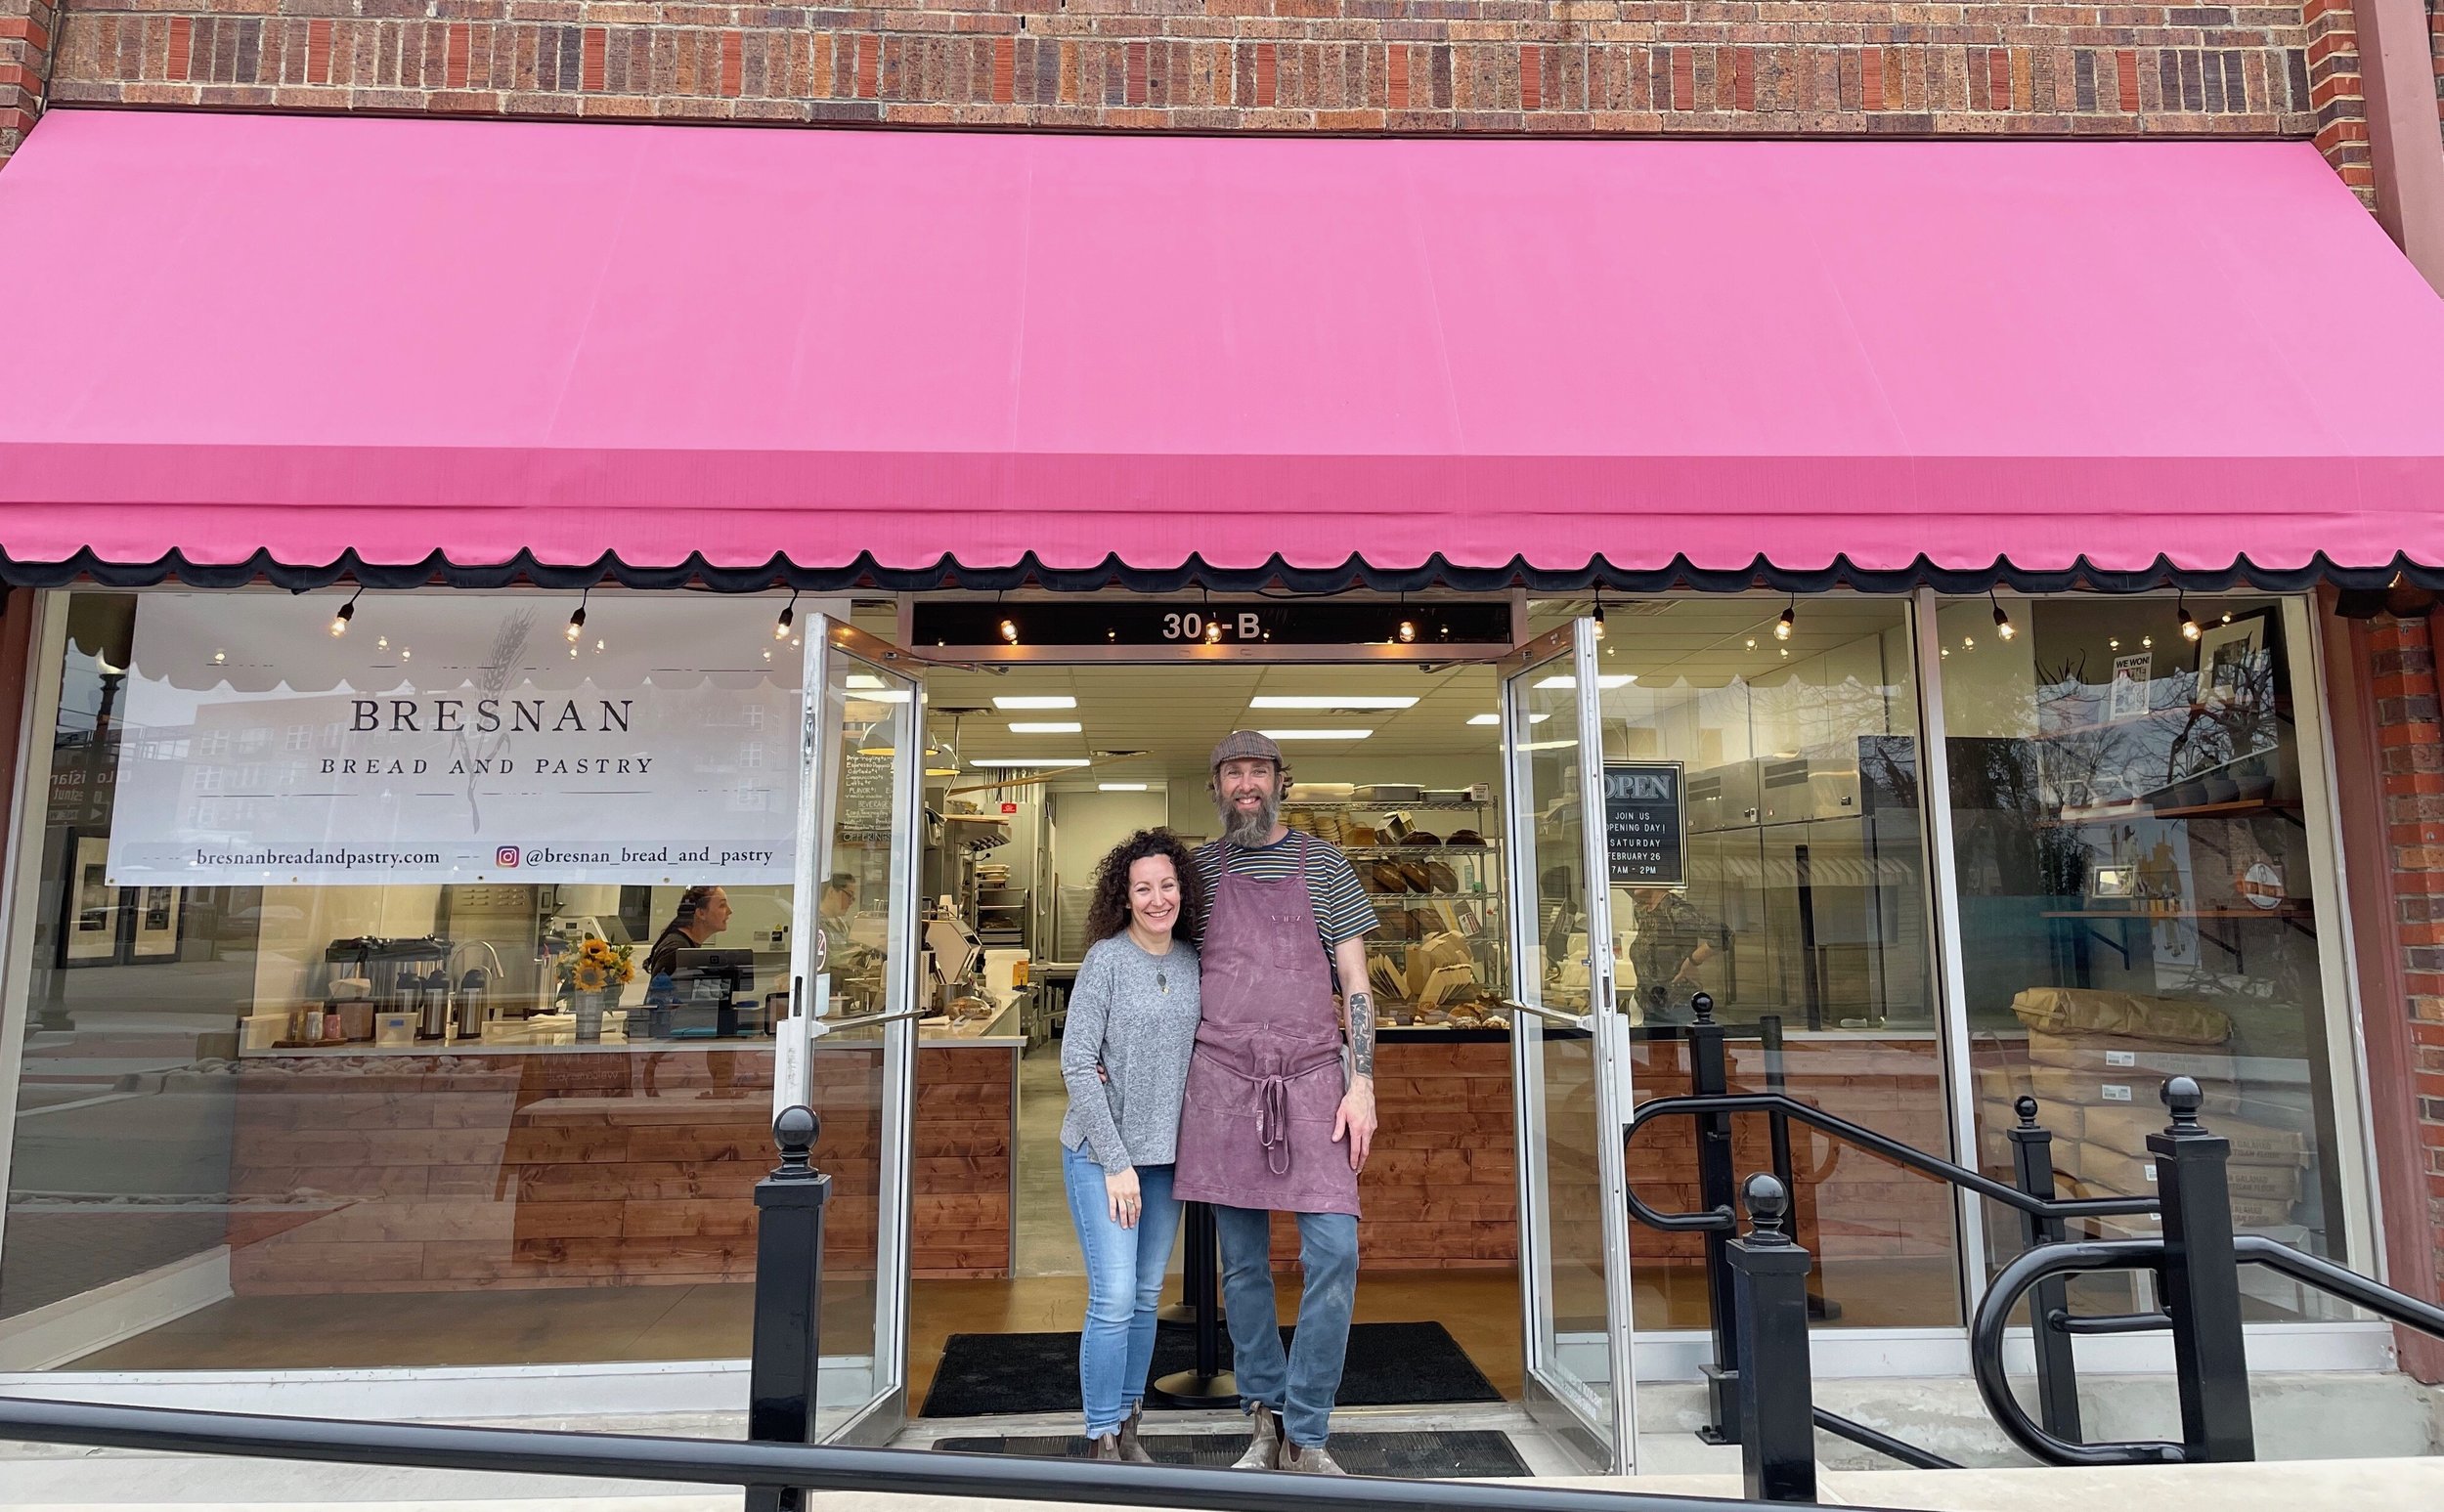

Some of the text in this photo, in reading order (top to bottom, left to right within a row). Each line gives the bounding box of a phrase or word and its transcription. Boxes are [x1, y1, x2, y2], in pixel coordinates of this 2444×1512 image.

[1162, 612, 1260, 639] 30-B
[2116, 660, 2129, 669] WE
[349, 699, 633, 733] BRESNAN
[321, 757, 653, 774] BREAD AND PASTRY
[1615, 812, 1650, 821] JOIN US
[1644, 823, 1666, 835] DAY!
[1609, 839, 1661, 848] SATURDAY
[196, 847, 440, 869] bresnanbreadandpastry.com
[526, 845, 773, 868] @bresnan_bread_and_pastry
[1650, 852, 1661, 861] 26
[1611, 865, 1629, 875] 7AM
[1639, 866, 1657, 875] 2PM
